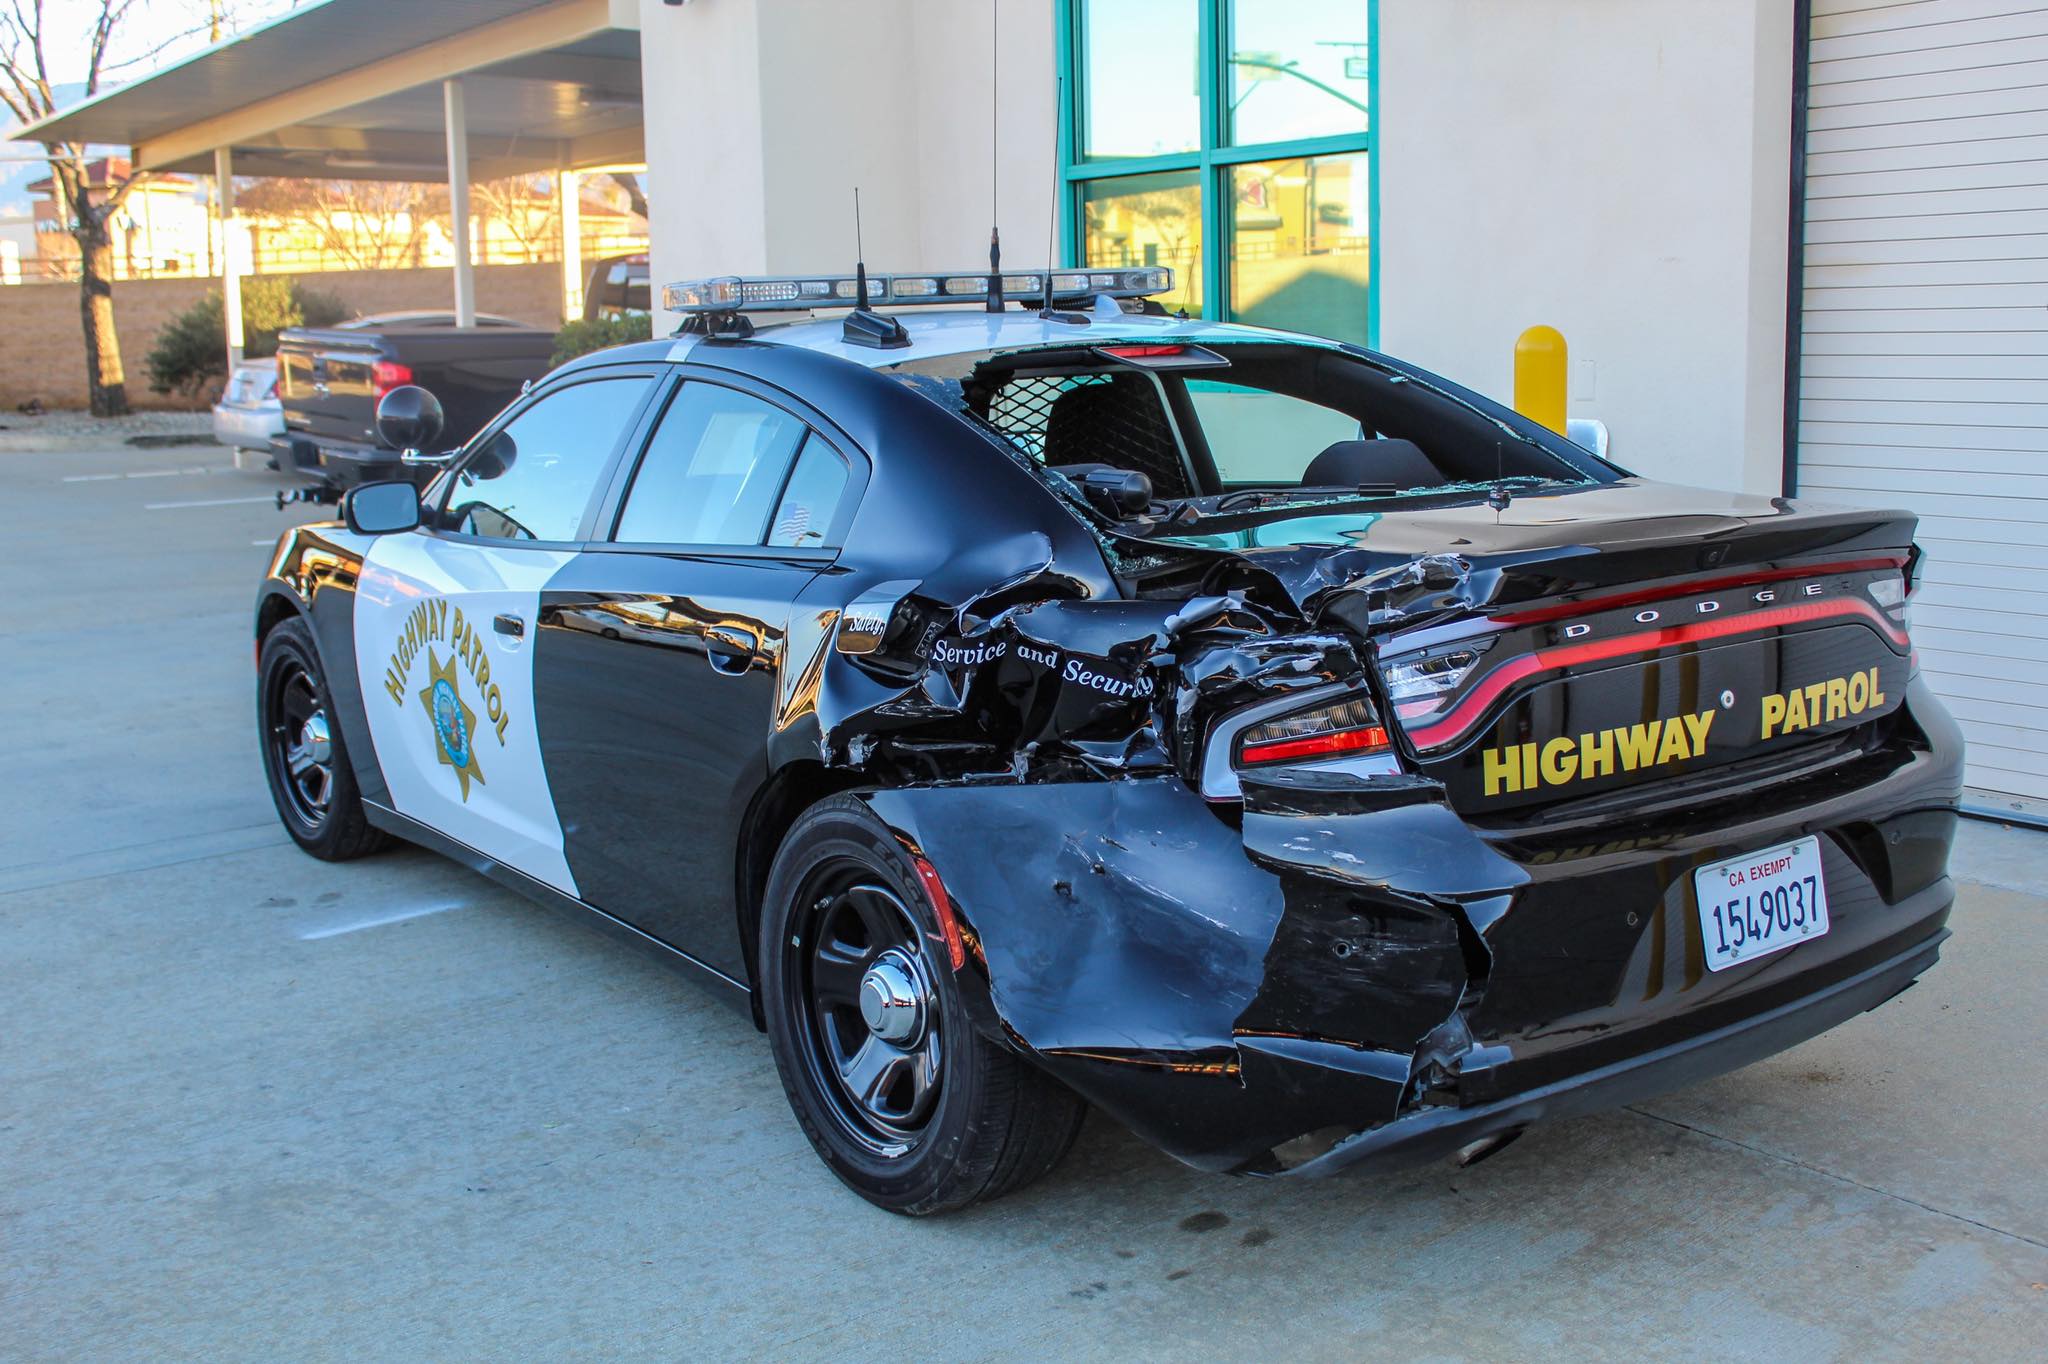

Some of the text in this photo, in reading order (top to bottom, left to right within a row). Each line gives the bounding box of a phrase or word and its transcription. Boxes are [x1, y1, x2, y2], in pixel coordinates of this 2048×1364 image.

[849, 611, 884, 635] Safety,
[932, 639, 1007, 663] Service
[1017, 644, 1058, 669] and
[1564, 583, 1823, 639] DODGE
[384, 598, 447, 707] HIGHWAY
[451, 606, 509, 747] PATROL
[1483, 666, 1885, 797] HIGHWAY PATROL
[1729, 856, 1792, 887] CA EXEMPT
[1713, 875, 1817, 953] 1549037
